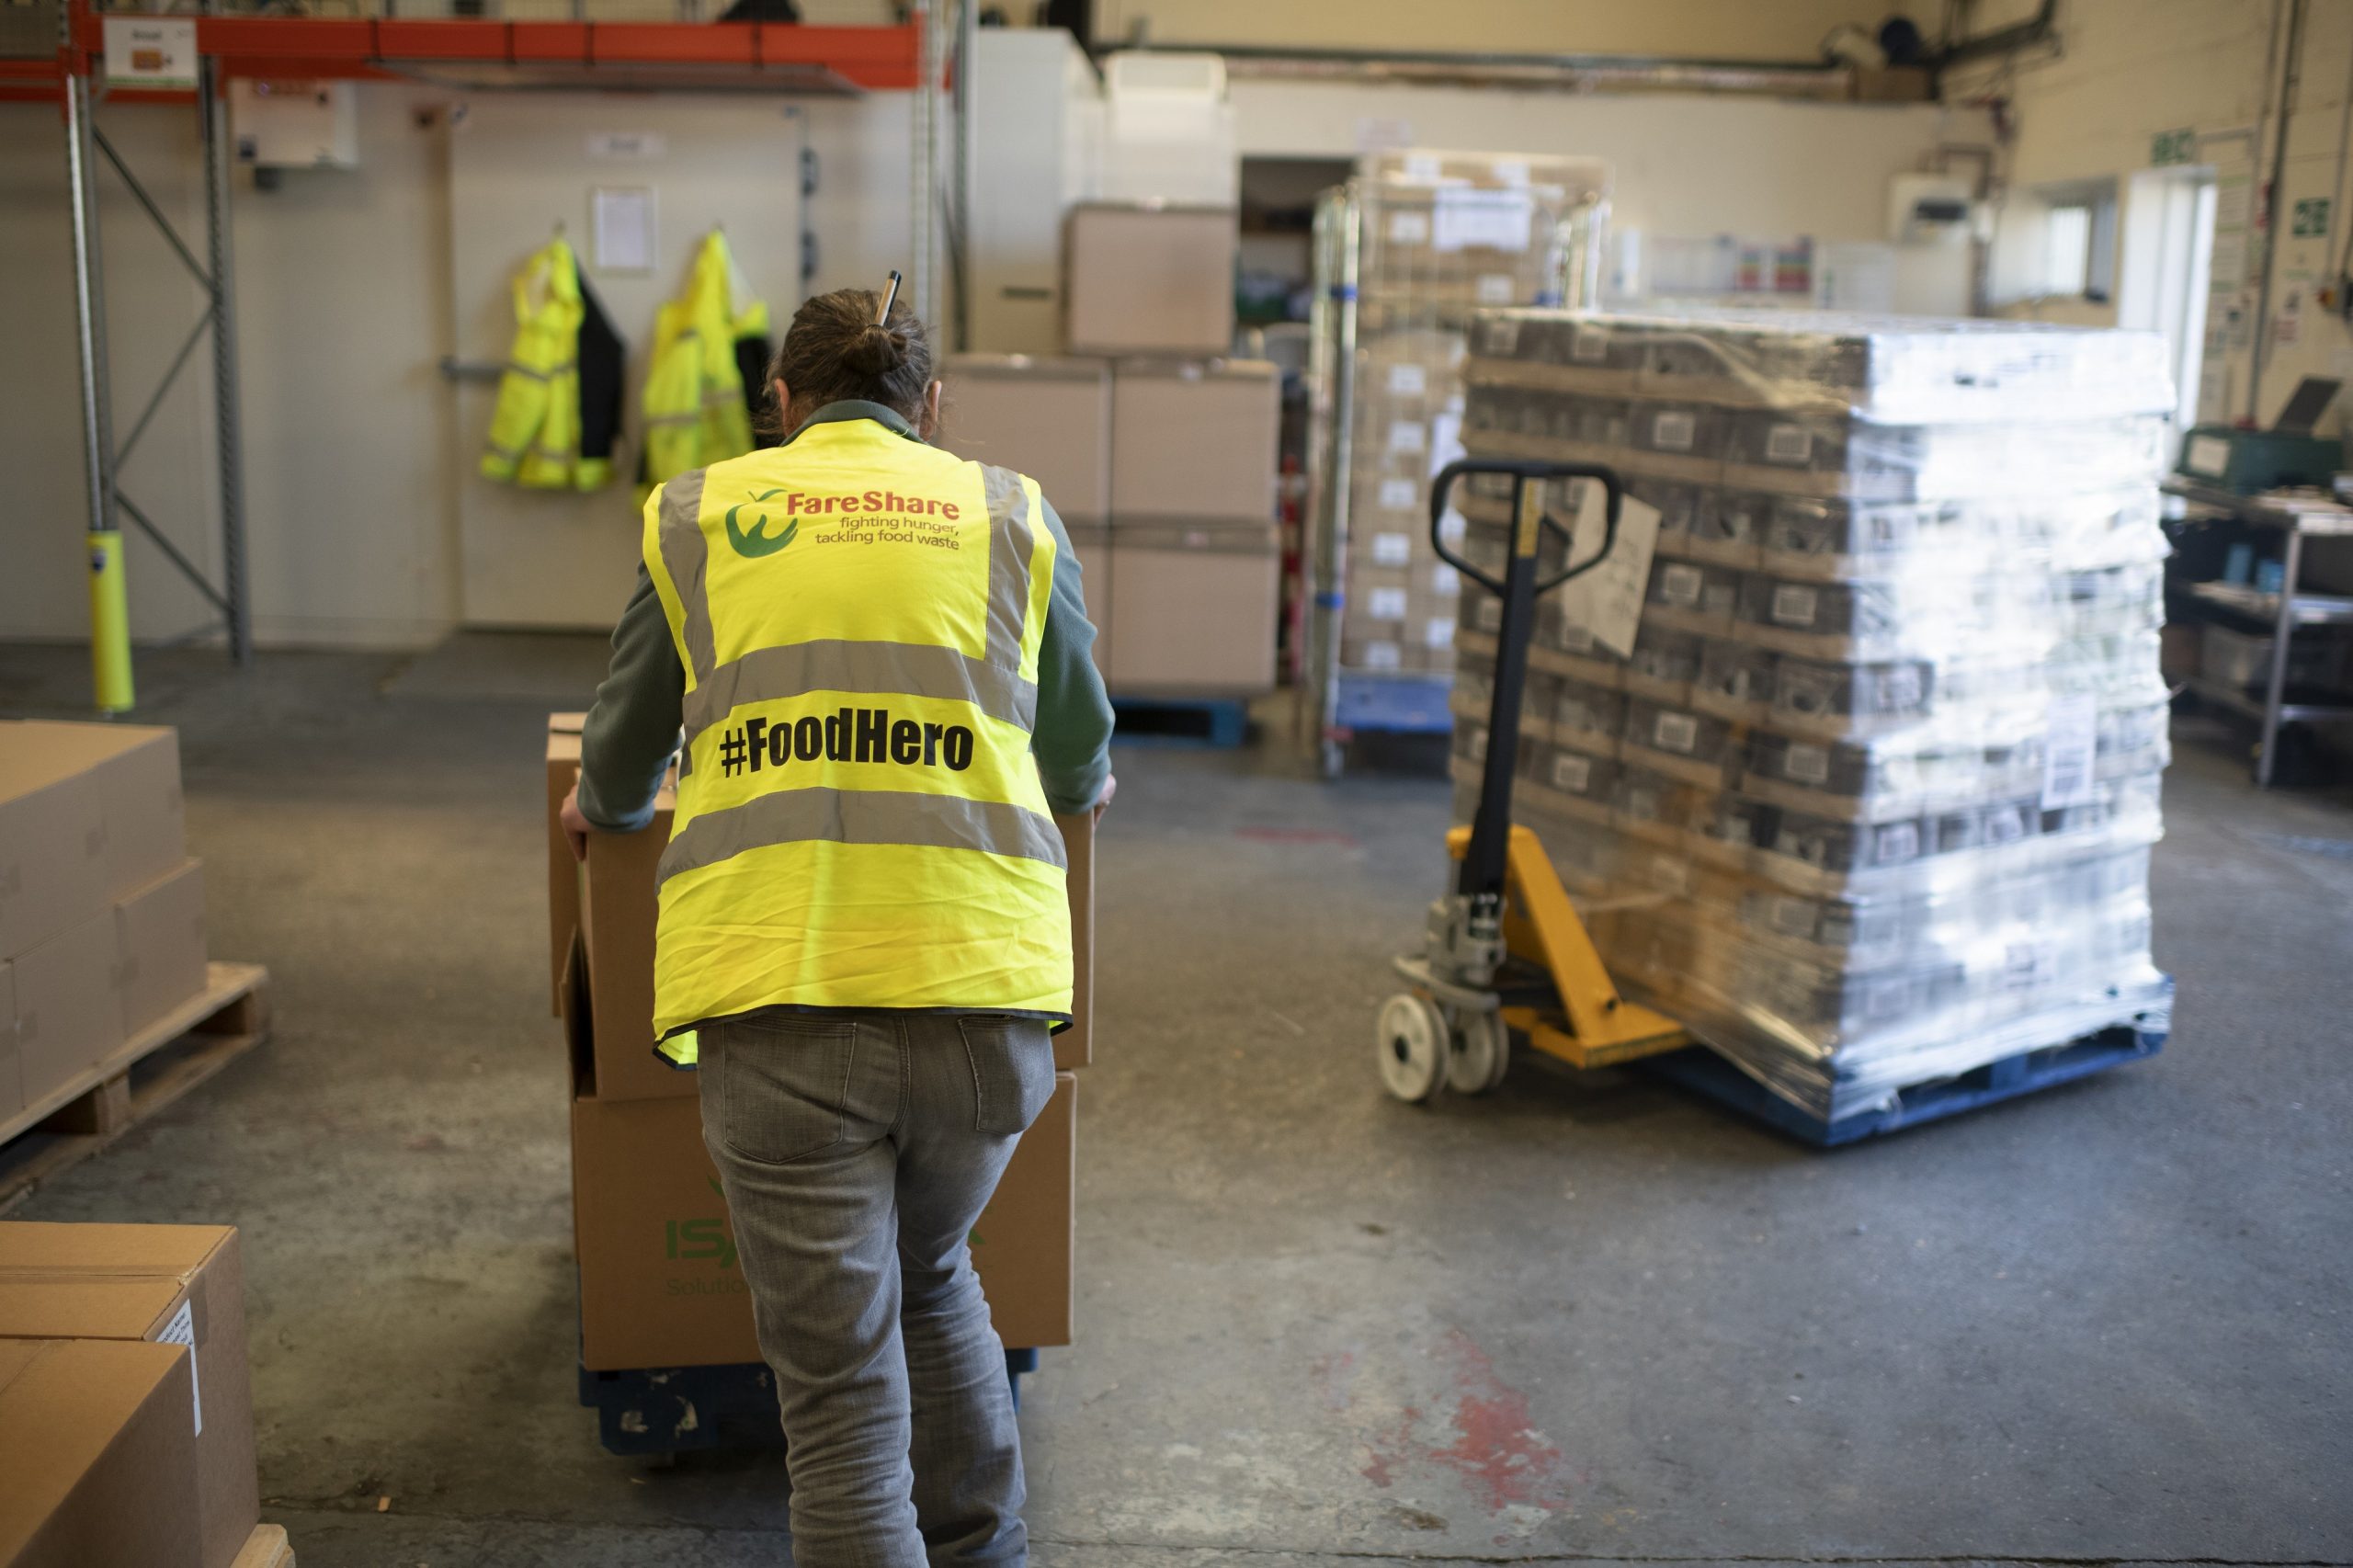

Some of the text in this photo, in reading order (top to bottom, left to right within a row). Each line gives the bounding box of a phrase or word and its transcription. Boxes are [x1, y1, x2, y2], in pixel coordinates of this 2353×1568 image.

[787, 491, 960, 520] FareShare
[839, 517, 960, 536] fighting hunger,
[814, 529, 960, 551] tackling food waste
[720, 707, 974, 778] #FoodHero
[667, 1278, 751, 1296] Solutio
